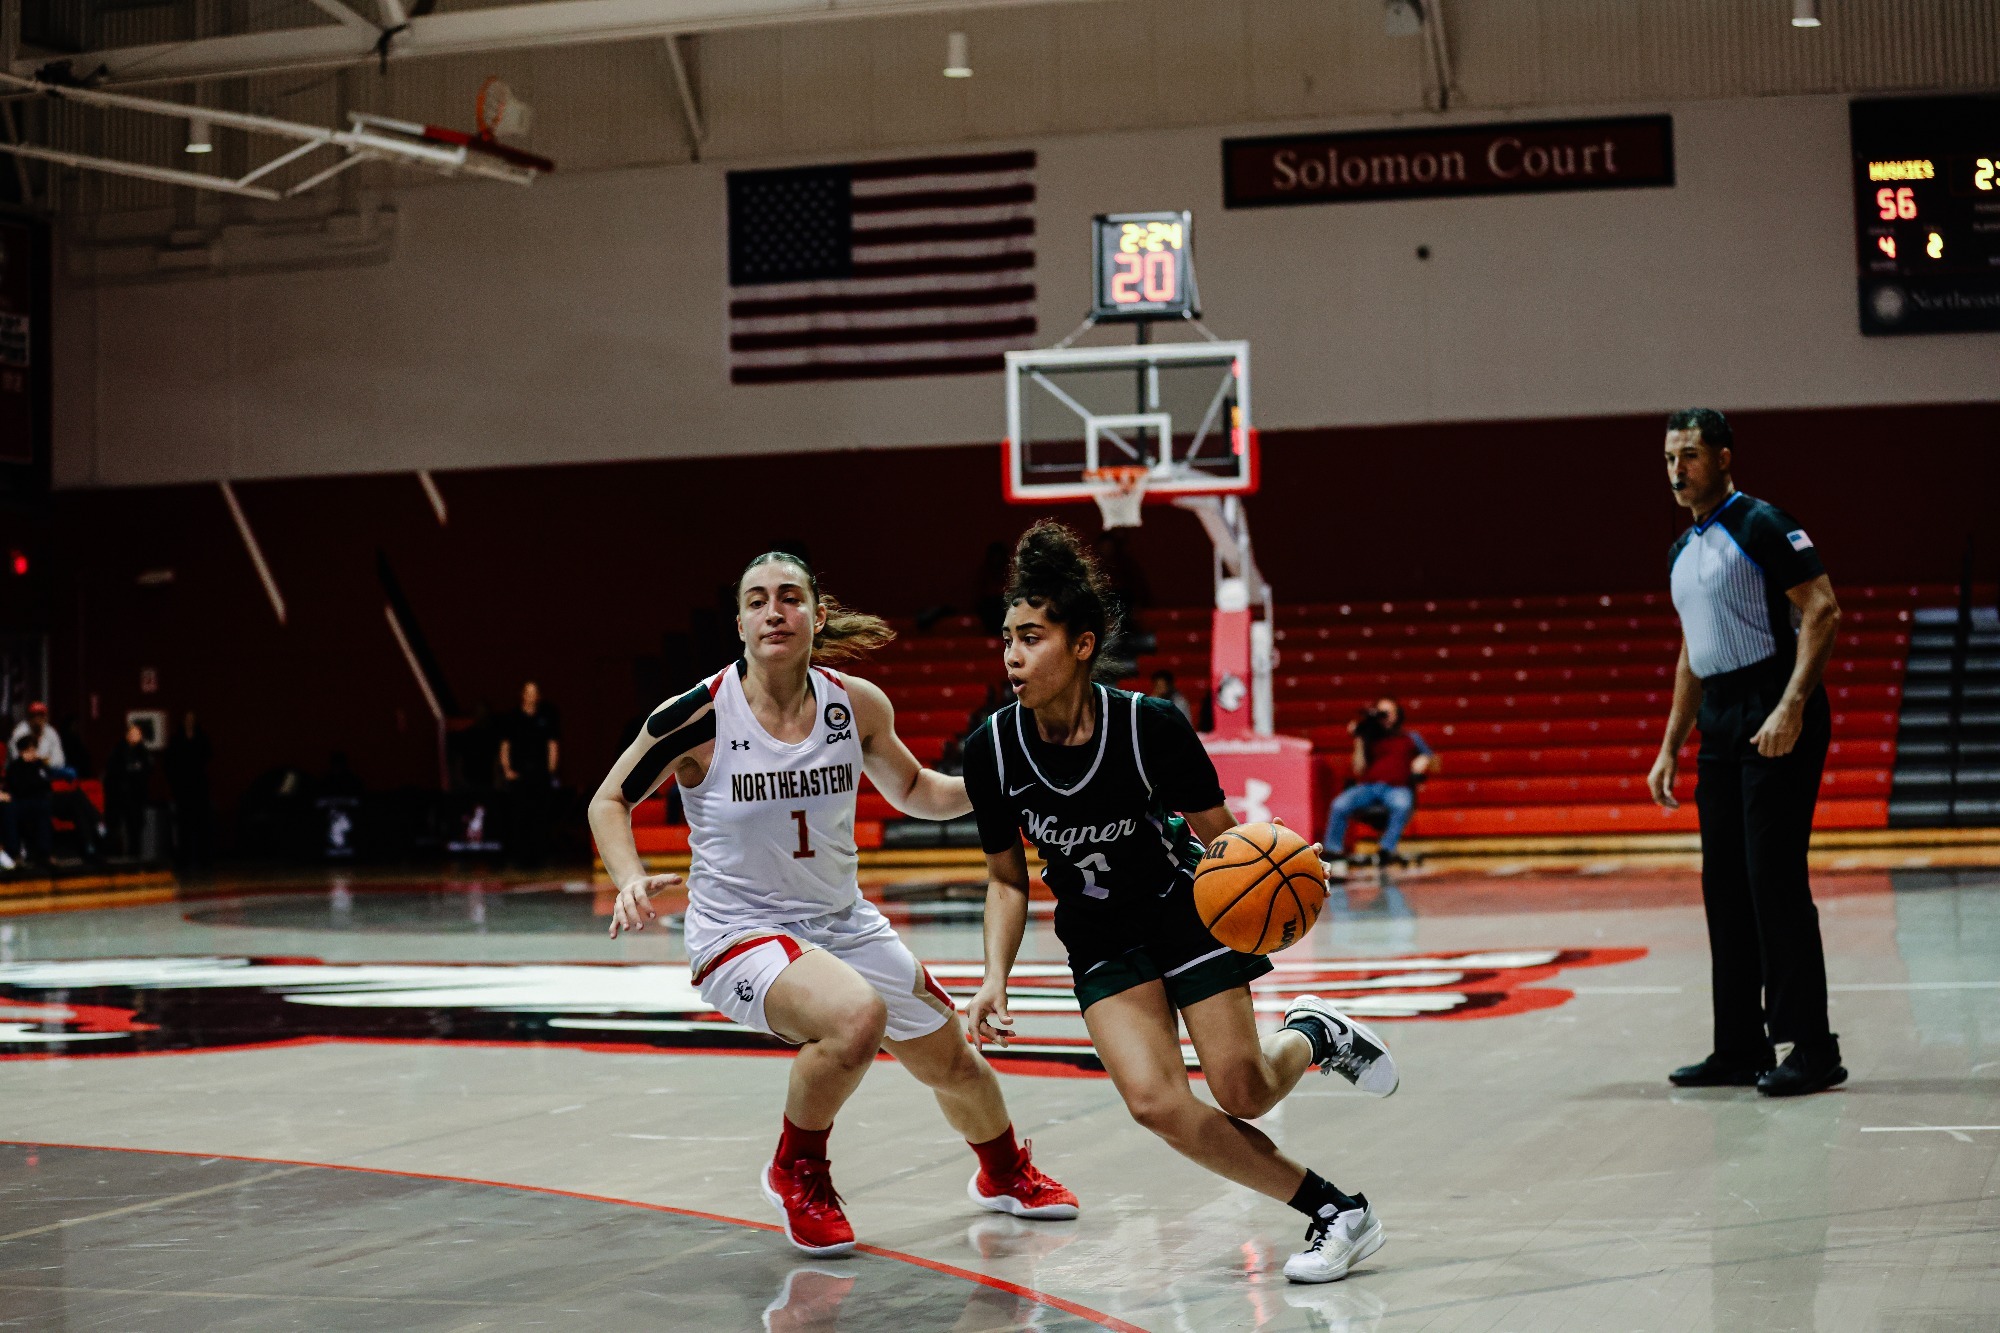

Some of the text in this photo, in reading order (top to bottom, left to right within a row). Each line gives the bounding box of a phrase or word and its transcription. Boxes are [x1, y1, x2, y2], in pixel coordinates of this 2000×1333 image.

[1272, 137, 1617, 191] Solomon Court
[1876, 187, 1917, 220] 56
[1111, 251, 1175, 303] 20
[826, 730, 851, 745] CAA
[731, 763, 853, 802] NORTHEASTERN
[790, 810, 816, 859] 1
[1021, 808, 1136, 856] Wagner
